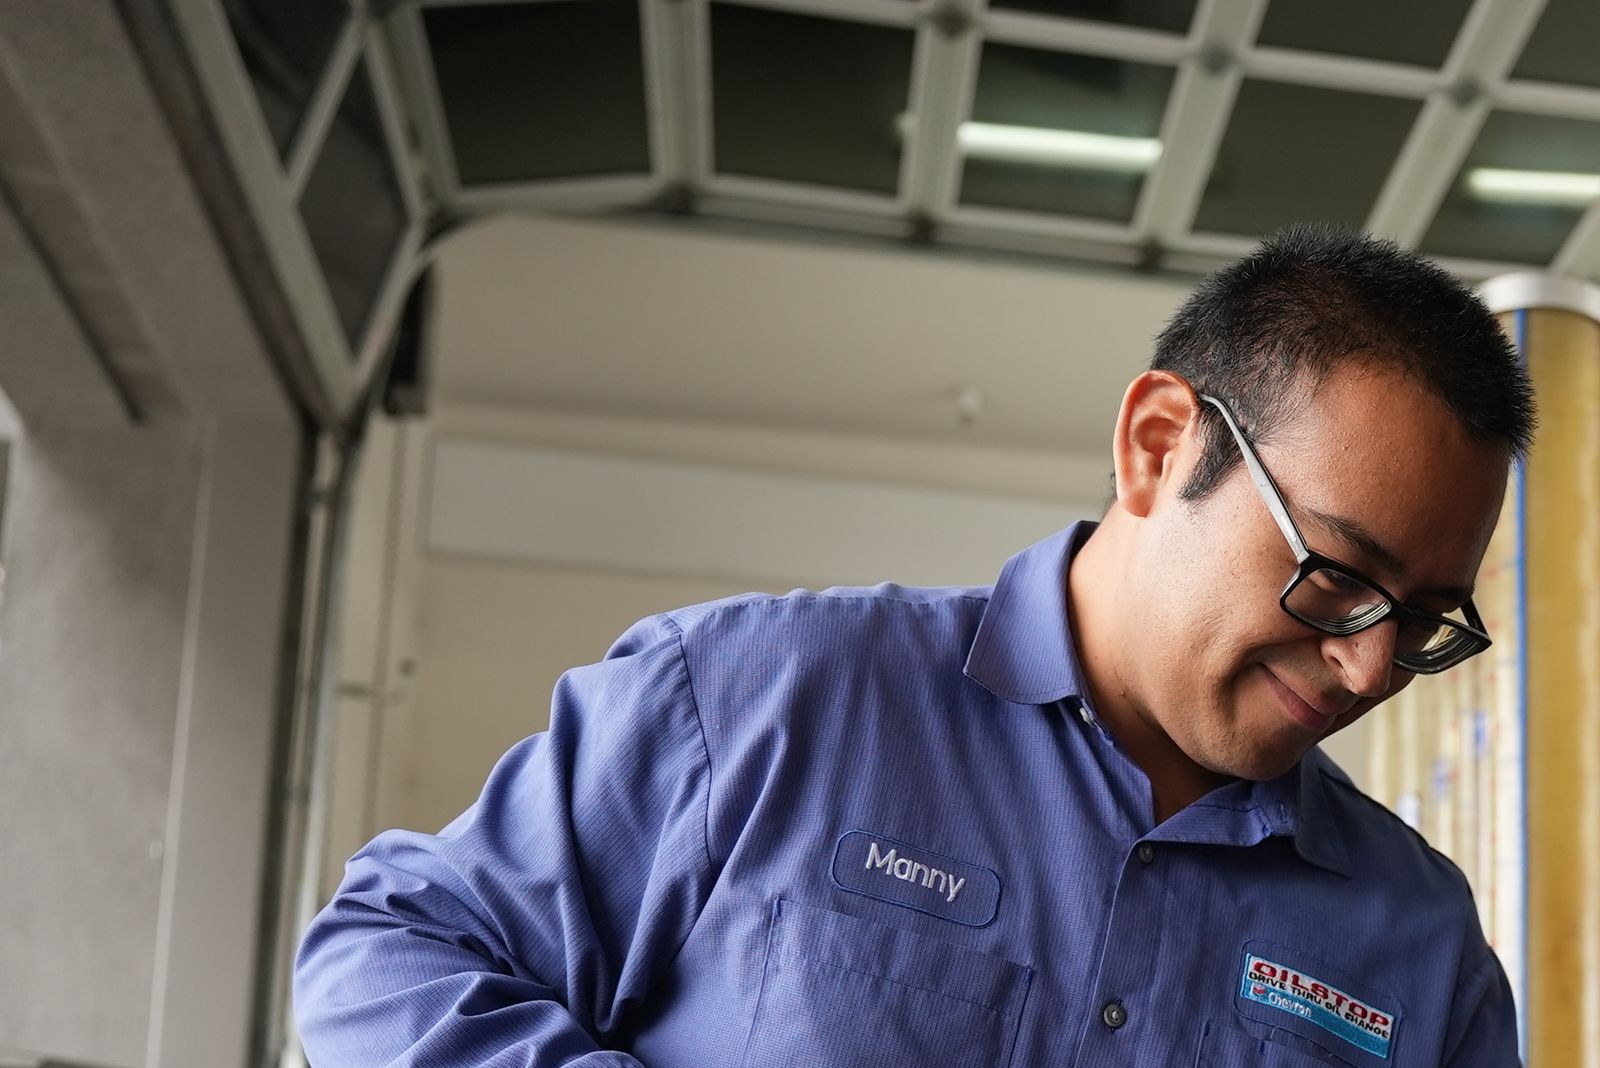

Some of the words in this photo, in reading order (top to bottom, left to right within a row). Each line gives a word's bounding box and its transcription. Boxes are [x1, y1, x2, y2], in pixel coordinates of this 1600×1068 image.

[865, 842, 966, 902] Manny
[1249, 971, 1286, 991] DRIVE
[1291, 986, 1322, 1005] THRU
[1325, 1002, 1341, 1017] OIL
[1344, 1012, 1390, 1039] CHANGE
[1254, 961, 1390, 1027] OILSTOP
[1268, 992, 1312, 1018] Chevron
